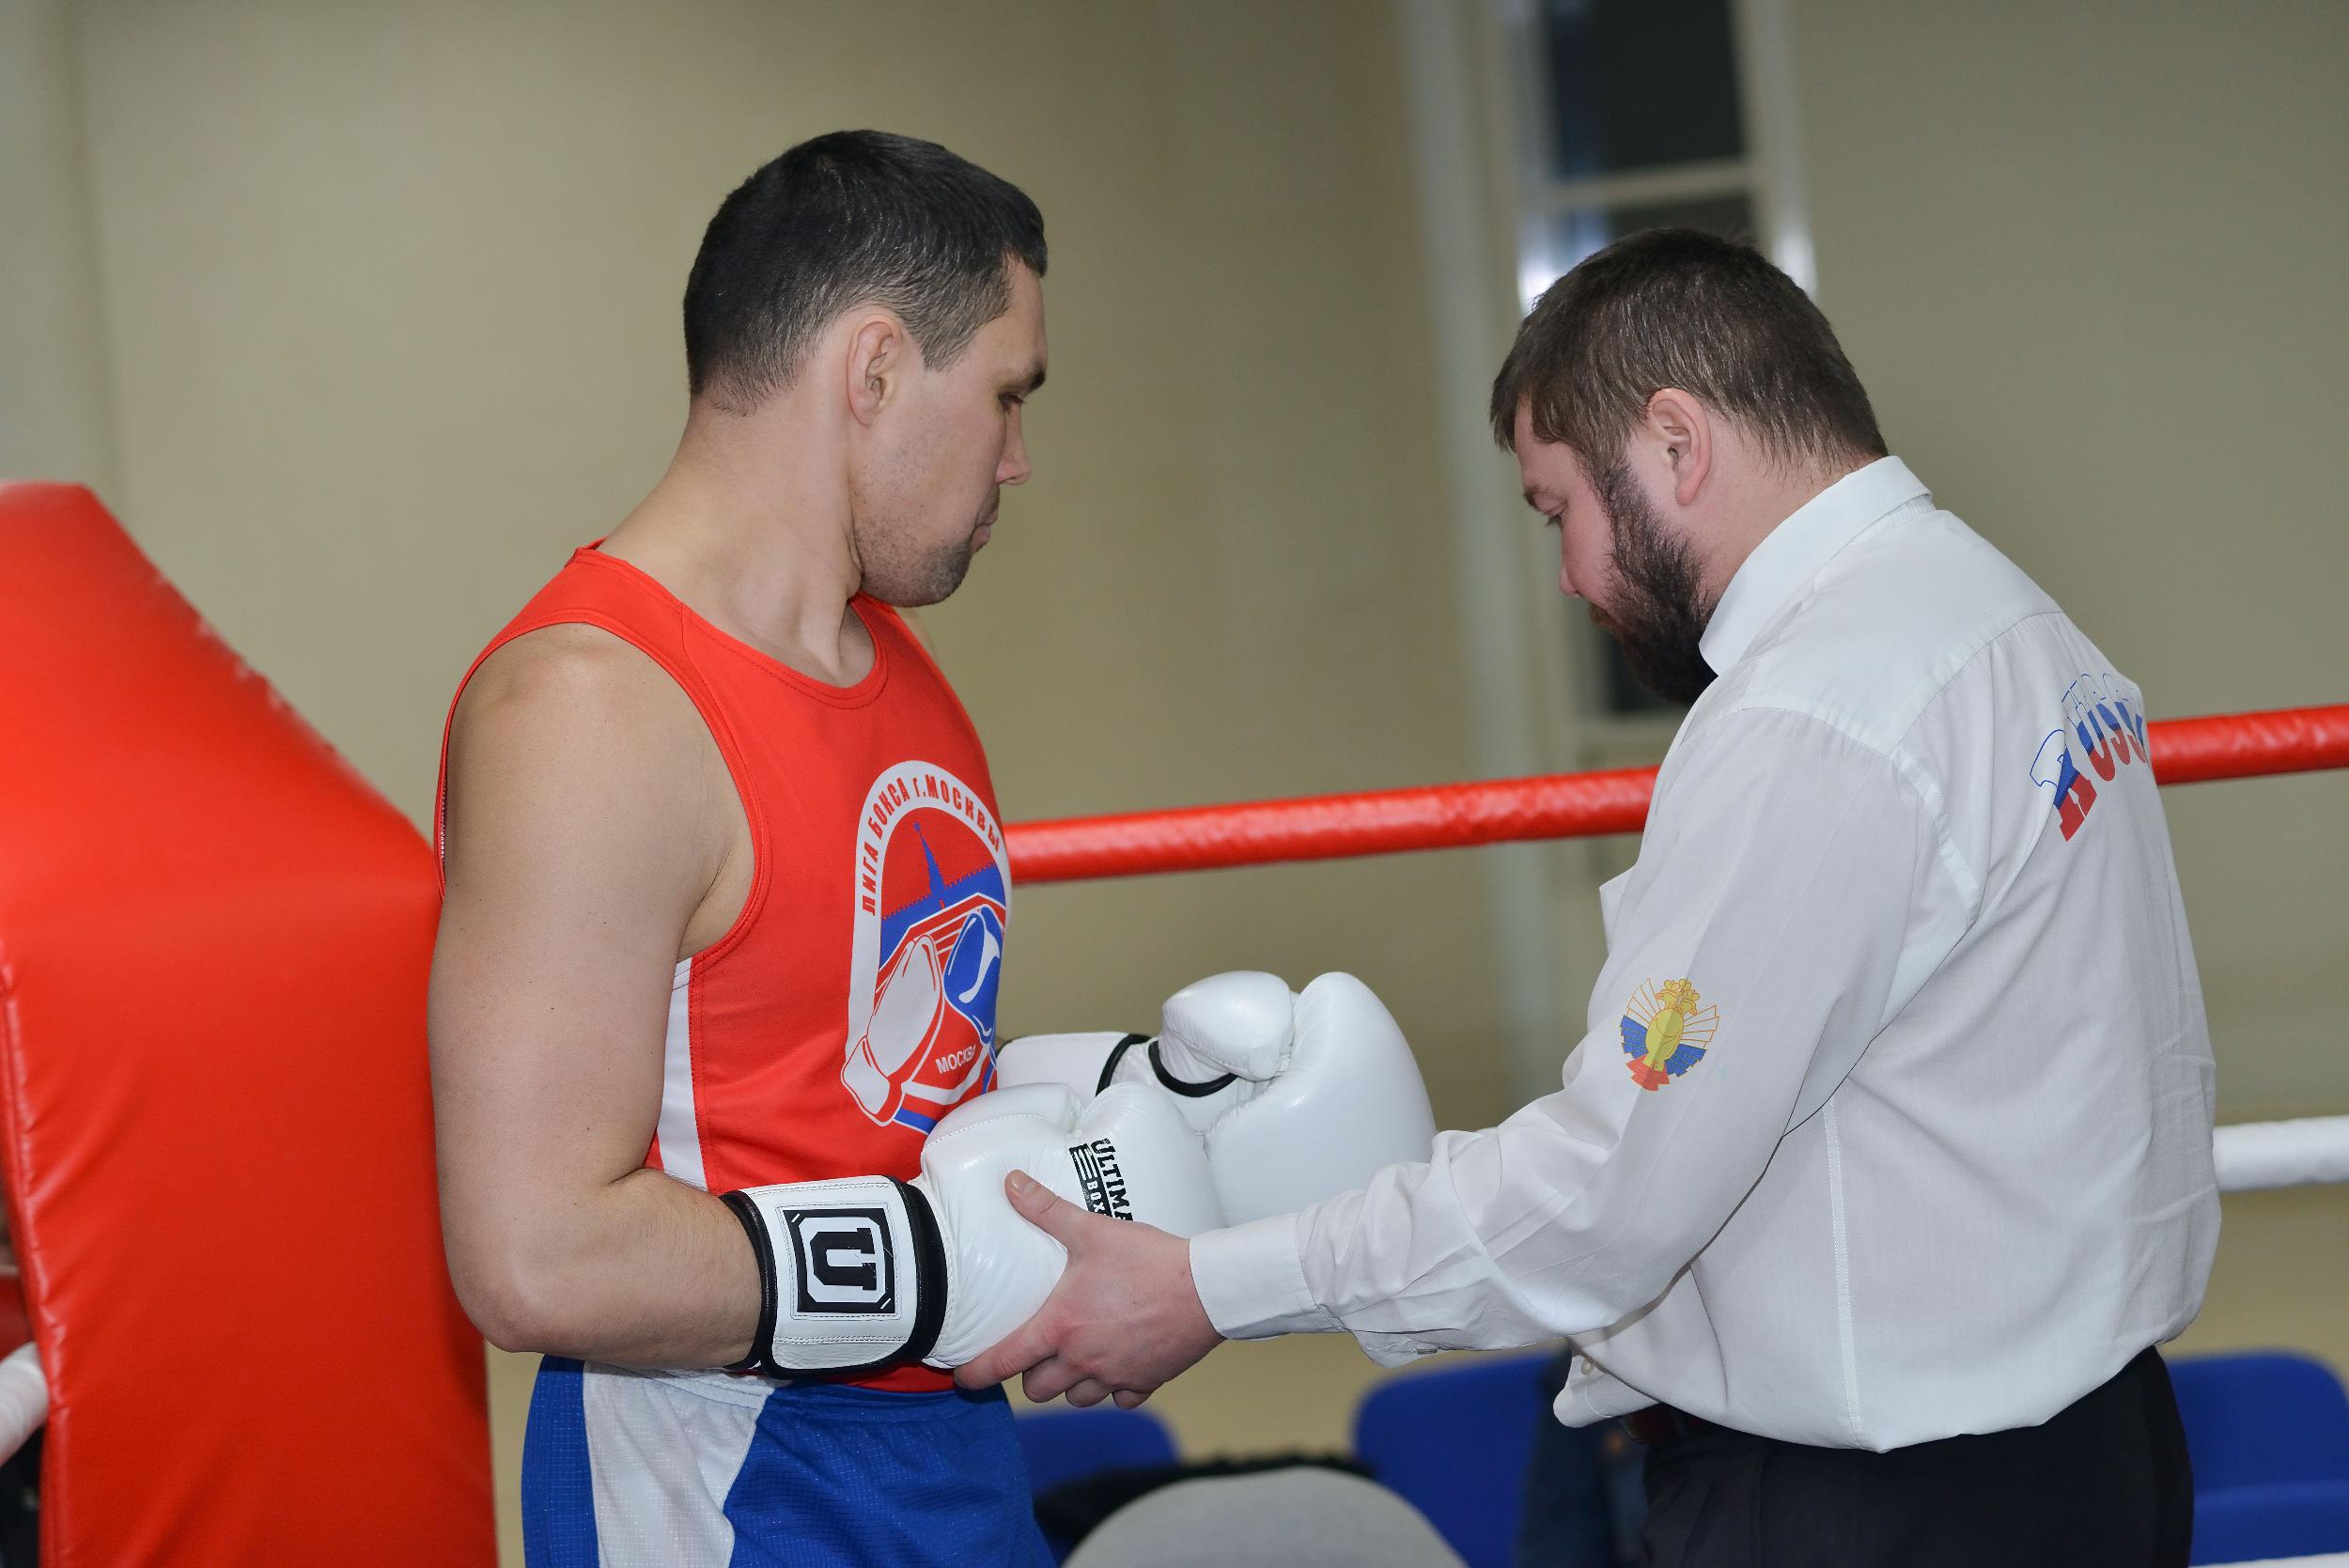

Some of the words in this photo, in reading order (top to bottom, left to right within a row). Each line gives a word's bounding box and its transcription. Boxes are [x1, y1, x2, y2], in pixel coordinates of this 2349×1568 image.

[868, 778, 910, 839] БОКСА
[862, 842, 879, 916] ЛИГА
[1086, 1180, 1107, 1216] BOX
[809, 1227, 878, 1291] U
